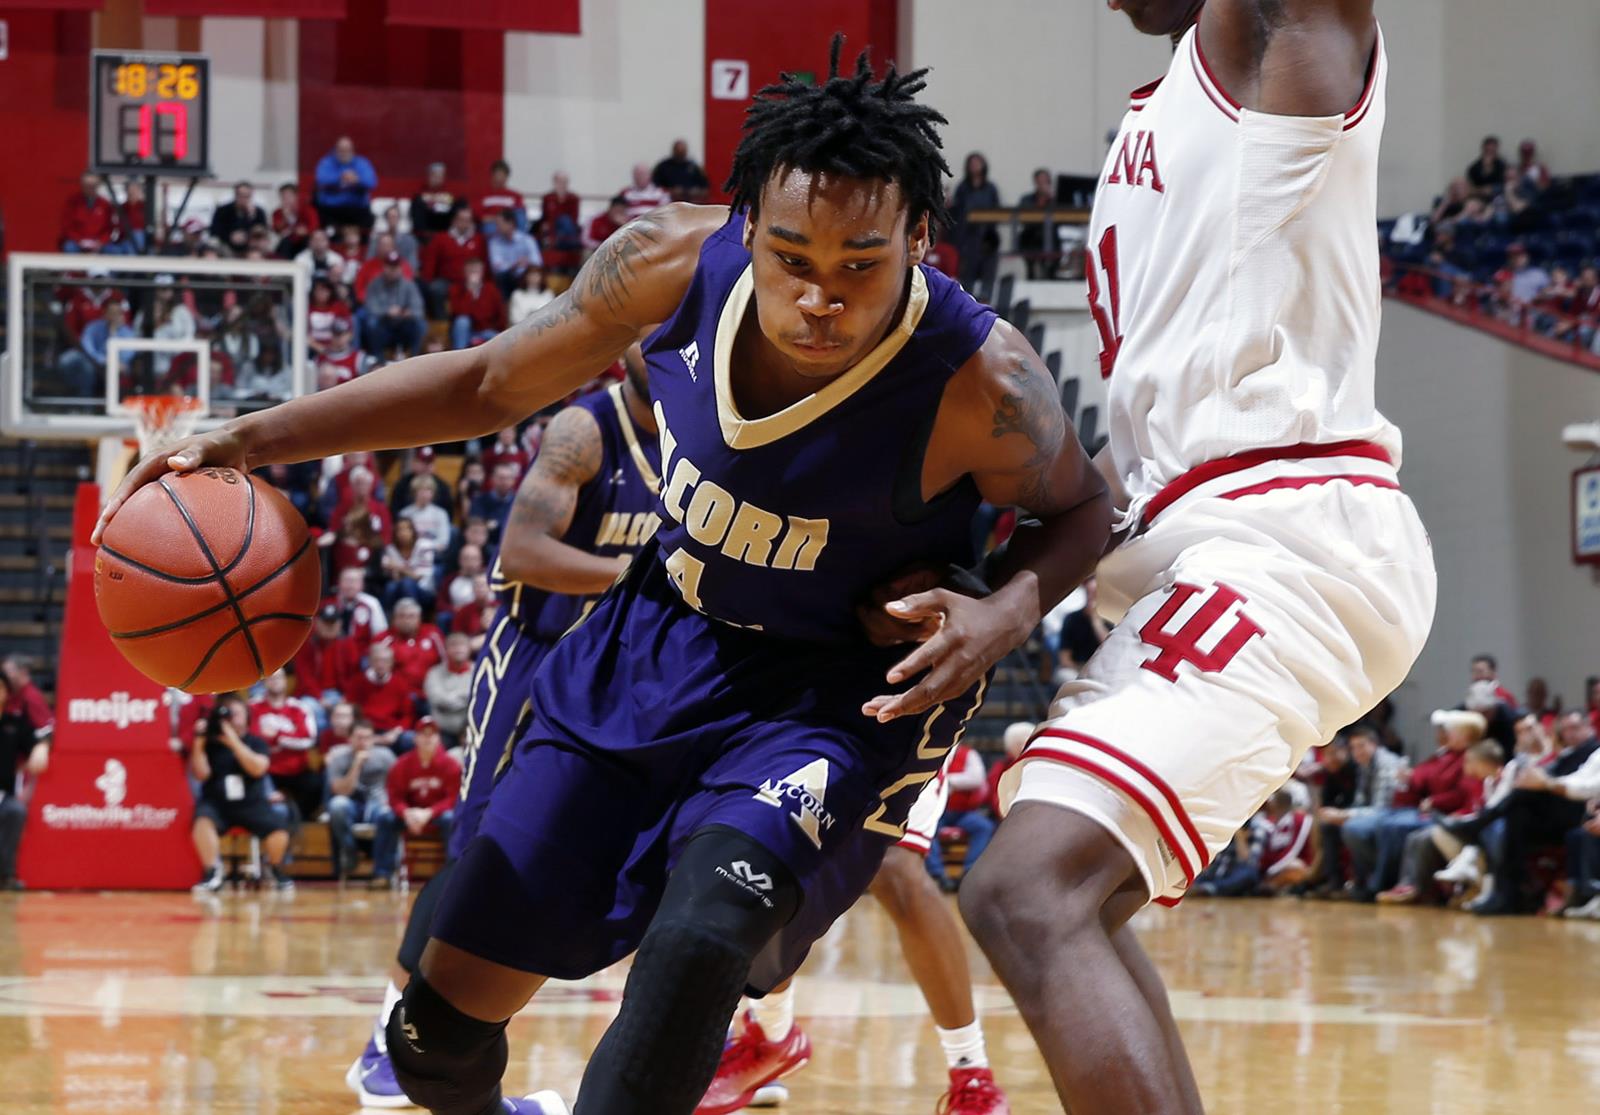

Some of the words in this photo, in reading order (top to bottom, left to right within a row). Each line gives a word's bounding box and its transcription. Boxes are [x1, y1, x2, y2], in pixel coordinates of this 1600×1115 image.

[116, 63, 200, 100] 18:26
[724, 67, 743, 92] 7
[138, 102, 189, 160] 17
[1106, 129, 1166, 194] NA
[68, 691, 160, 730] meijer
[757, 777, 837, 832] ALCORN
